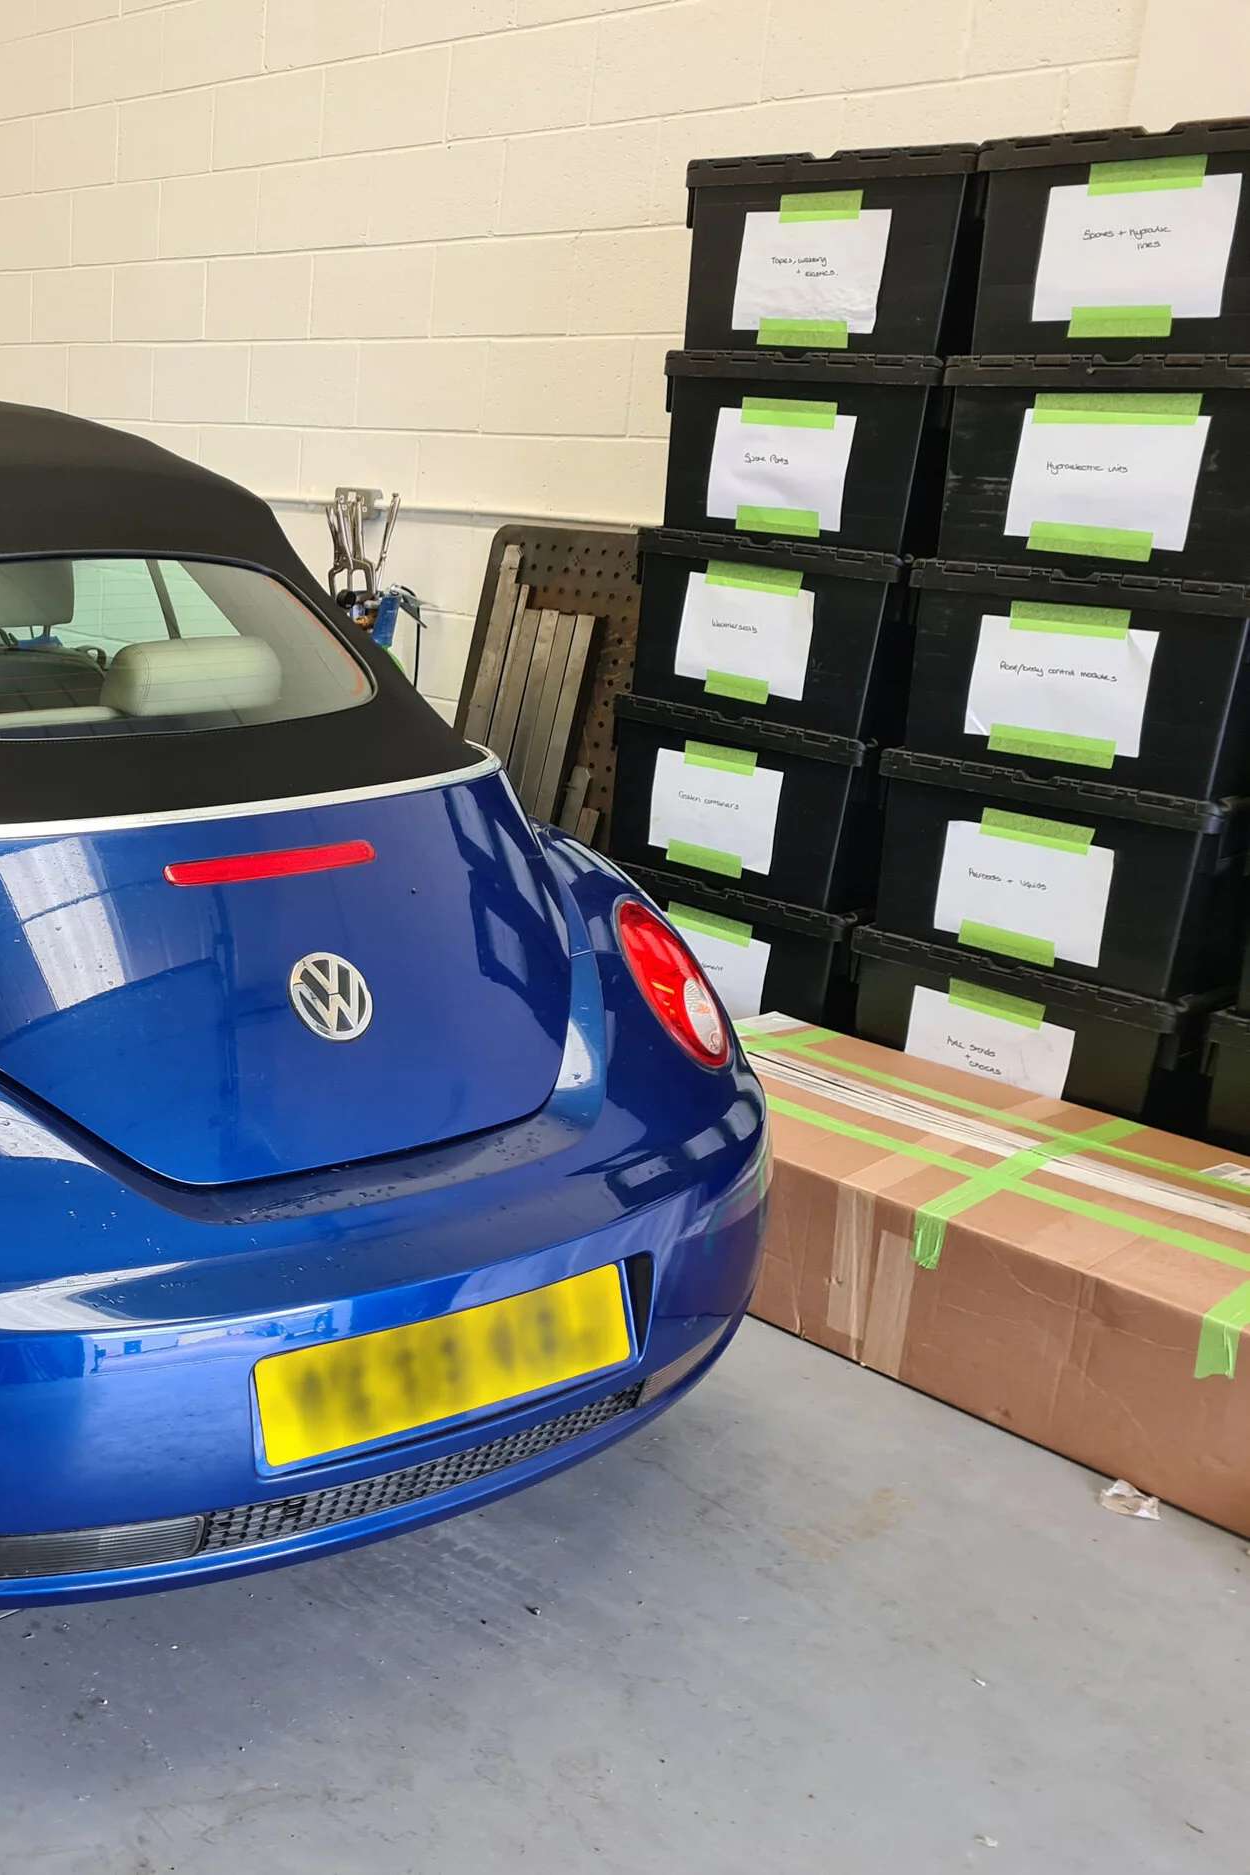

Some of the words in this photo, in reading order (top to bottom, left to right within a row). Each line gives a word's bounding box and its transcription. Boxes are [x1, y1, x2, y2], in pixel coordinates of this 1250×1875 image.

[1047, 668, 1075, 677] control
[1080, 671, 1118, 682] modules
[291, 952, 373, 1041] VW
